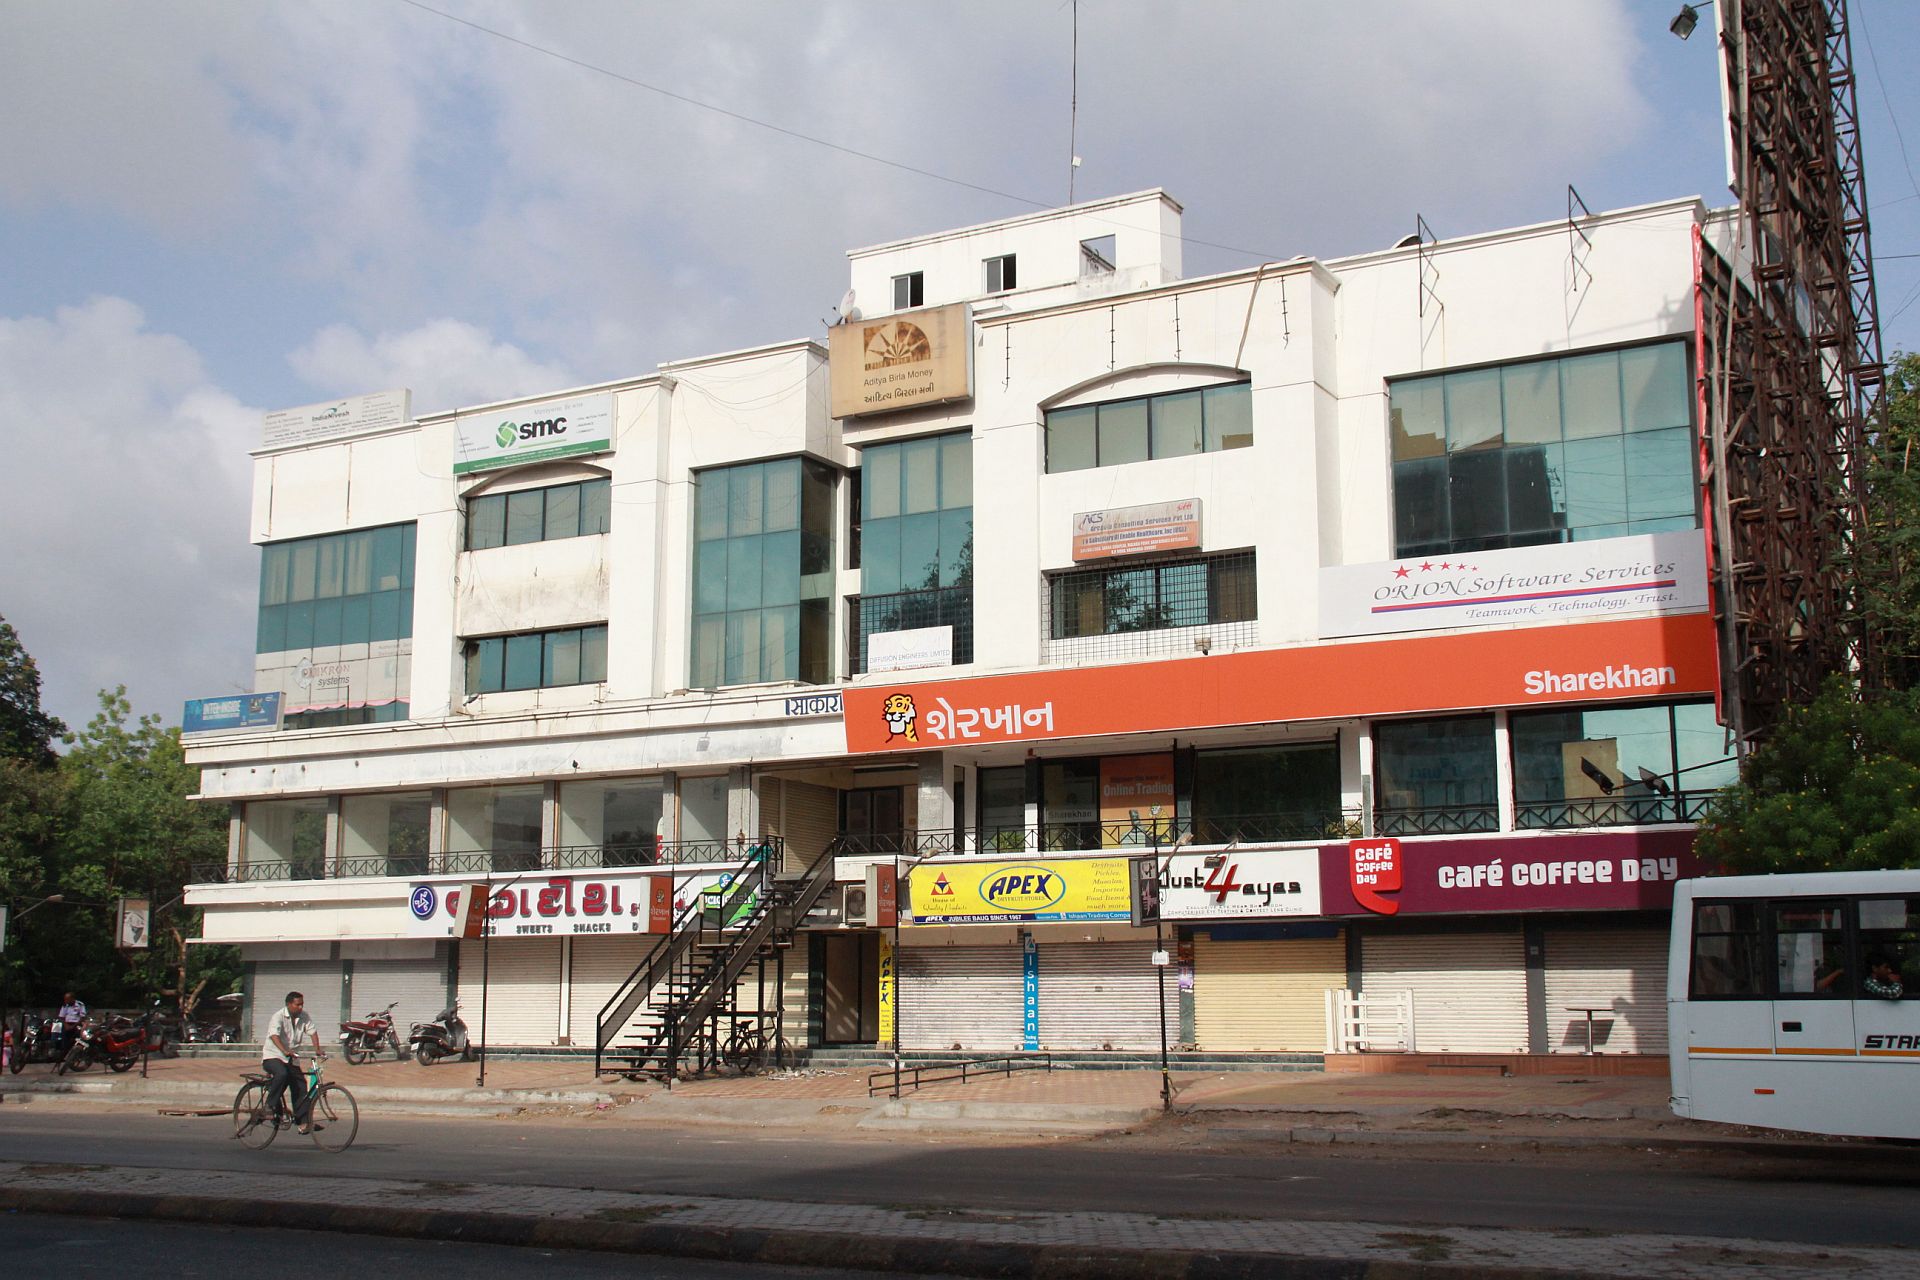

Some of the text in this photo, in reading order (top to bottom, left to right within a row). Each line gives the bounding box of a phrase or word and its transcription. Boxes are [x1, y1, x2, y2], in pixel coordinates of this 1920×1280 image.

[863, 368, 934, 387] Aditya Birla Money
[894, 387, 917, 398] બિરલા
[919, 382, 935, 394] મની
[519, 416, 567, 440] smc
[1082, 512, 1104, 525] ACS
[1373, 561, 1676, 601] ORION Software Services
[930, 649, 951, 658] LIMITED
[317, 676, 350, 687] systems
[1523, 664, 1677, 695] Sharekhan
[926, 697, 1054, 740] શેરખાન
[1103, 782, 1174, 797] Online Trading
[1355, 843, 1393, 862] Café
[1355, 860, 1394, 873] Coffee
[1438, 857, 1678, 889] Café Coffee Day
[988, 873, 1053, 901] APEX
[1158, 866, 1204, 889] Just
[1203, 855, 1242, 903] 4
[1356, 873, 1378, 886] Day
[516, 922, 611, 935] SWEETS SNACKS
[880, 956, 892, 1006] APEX
[1026, 954, 1036, 1032] Ishaan
